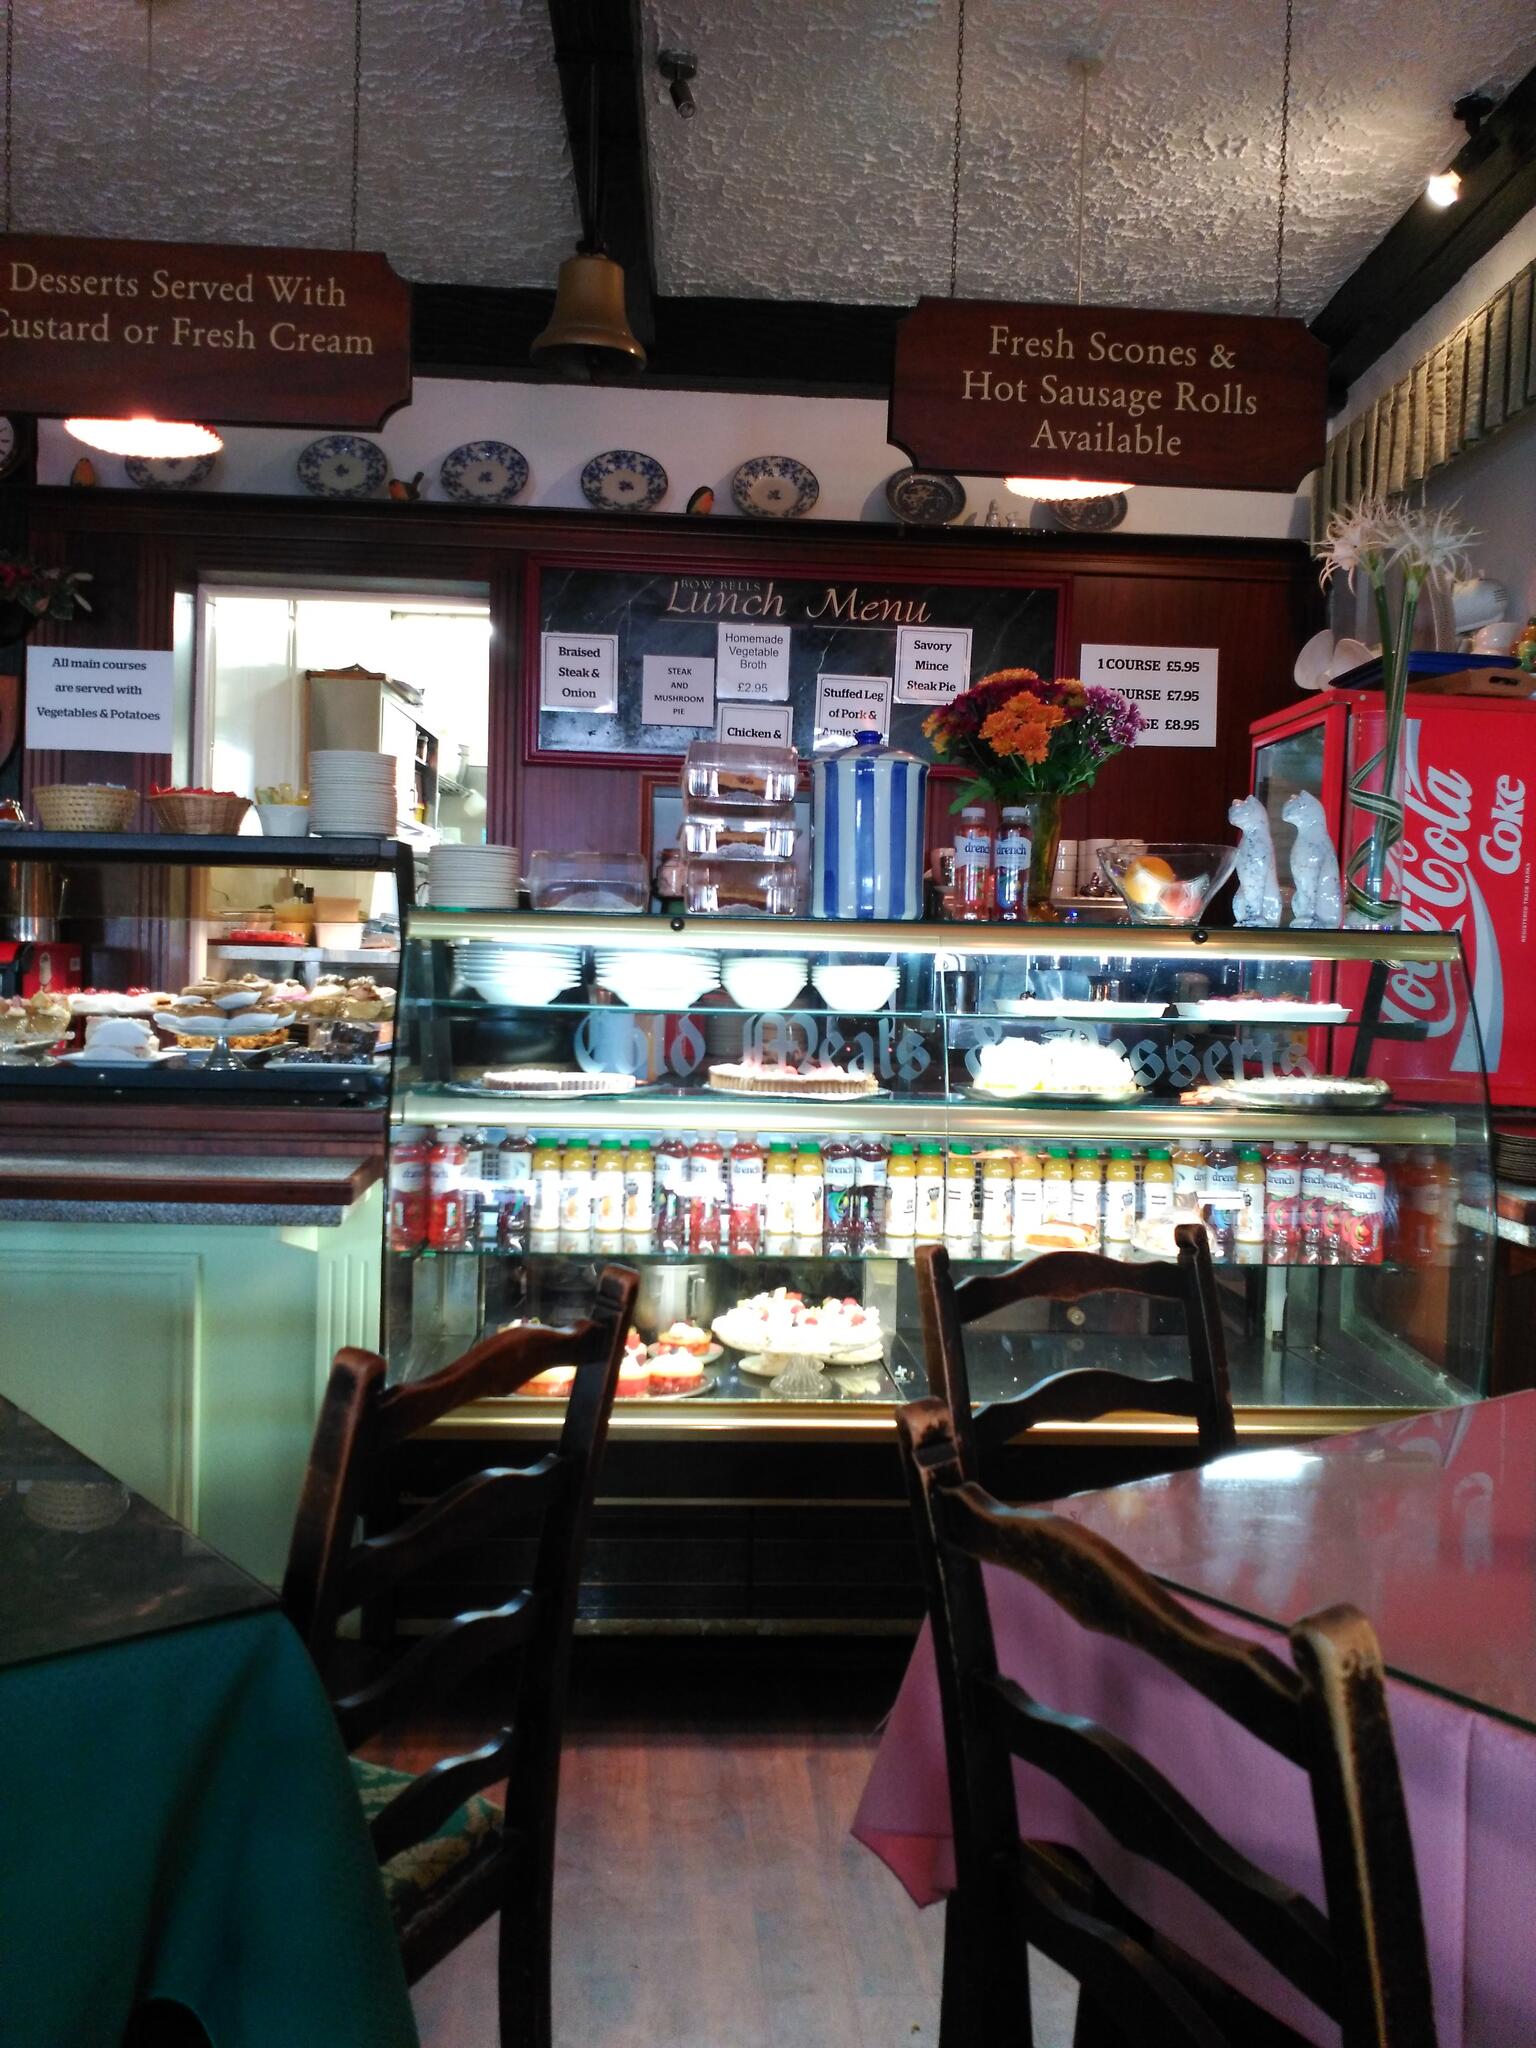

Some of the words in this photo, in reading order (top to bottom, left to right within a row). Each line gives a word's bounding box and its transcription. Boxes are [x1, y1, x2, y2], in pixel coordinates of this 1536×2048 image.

[10, 262, 139, 297] Desserts
[151, 270, 254, 302] Served
[267, 274, 346, 307] With
[0, 308, 110, 342] Custard
[124, 324, 159, 345] or
[172, 317, 256, 350] Fresh
[269, 323, 374, 355] Cream
[989, 324, 1075, 360] Fresh
[1088, 331, 1197, 367] Scones
[1209, 343, 1236, 370] &
[962, 370, 1028, 403] Hot
[1040, 375, 1162, 417] Sausage
[1174, 382, 1258, 416] Rolls
[1031, 419, 1181, 457] Available
[681, 579, 714, 590] BOW
[720, 581, 761, 592] BELLS
[666, 581, 787, 617] Lunch
[806, 587, 932, 624] Menu
[725, 633, 784, 645] Homemade
[558, 646, 601, 658] Braised
[729, 646, 780, 658] Vegetable
[913, 640, 952, 652] Savory
[52, 657, 69, 668] All
[71, 659, 100, 669] main
[102, 661, 147, 671] courses
[740, 659, 767, 670] Broth
[915, 660, 949, 671] Mince
[1098, 658, 1104, 669] 1
[1106, 658, 1160, 671] COURSE
[1166, 661, 1200, 673] £5.95
[558, 667, 589, 678] Steak
[591, 668, 600, 678] &
[668, 667, 692, 676] STEAK
[55, 684, 73, 692] are
[75, 684, 114, 694] served
[116, 685, 142, 695] with
[671, 681, 689, 689] AND
[737, 682, 768, 693] £2.95
[907, 680, 938, 691] Steak
[938, 681, 956, 692] Pie
[562, 687, 596, 698] Onion
[654, 694, 705, 703] MUSHROOM
[823, 687, 862, 699] Stuffed
[865, 690, 884, 702] Leg
[1110, 688, 1160, 700] URSE
[1167, 690, 1199, 701] £7.95
[36, 706, 98, 719] Vegetables
[100, 709, 109, 718] &
[110, 709, 161, 721] Potatoes
[828, 708, 840, 718] of
[841, 709, 867, 719] Pork
[868, 710, 877, 720] &
[1165, 719, 1199, 731] £8.95
[727, 727, 771, 738] Chicken
[773, 729, 782, 739] &
[1479, 774, 1526, 875] Coke
[996, 843, 1027, 855] drench
[574, 1010, 706, 1078] Cold
[742, 1013, 931, 1081] Meals
[1040, 1017, 1315, 1087] sserts
